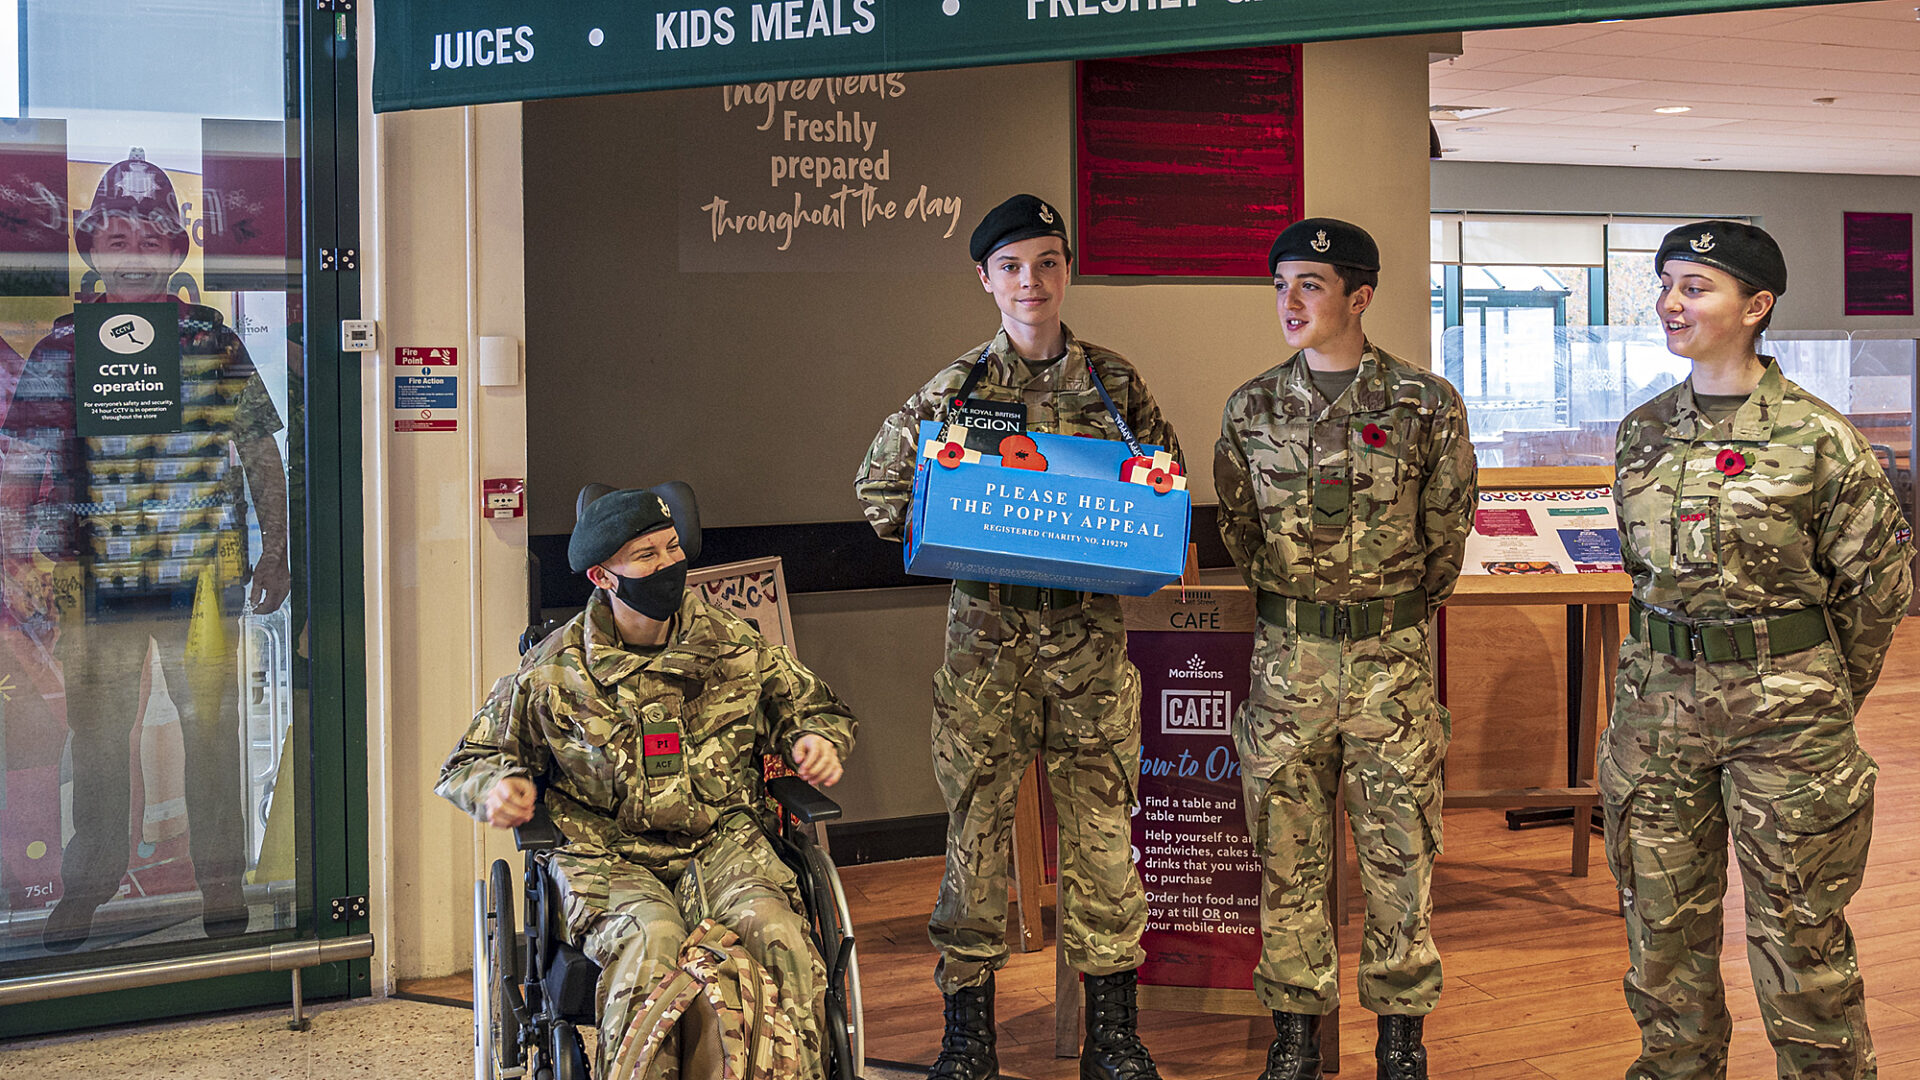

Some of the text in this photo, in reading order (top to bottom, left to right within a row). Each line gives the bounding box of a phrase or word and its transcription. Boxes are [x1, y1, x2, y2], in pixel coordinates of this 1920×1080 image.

[430, 0, 876, 71] JUICES KIDS MEALS
[783, 110, 878, 152] Freshly
[771, 149, 890, 188] prepared
[701, 182, 962, 251] throughout the day
[115, 324, 132, 335] CCTV
[402, 348, 418, 356] Fire
[402, 357, 423, 365] Point
[99, 363, 157, 376] CCTV in
[93, 380, 164, 396] operation
[141, 406, 168, 414] operation
[970, 408, 993, 417] ROYAL
[994, 411, 1021, 420] BRITISH
[955, 416, 1020, 433] LEGION
[1114, 413, 1133, 441] APPEAL
[986, 482, 1134, 514] PLEASE HELP
[950, 497, 1164, 538] THE POPPY APPEAL
[1680, 512, 1706, 522] CADET
[983, 523, 1128, 549] REGISTERED CHARITY NO. 219279
[1170, 607, 1221, 629] CAFÉ
[1169, 668, 1224, 679] Morrisons
[656, 760, 672, 769] ACF
[1140, 745, 1177, 776] ow
[1178, 748, 1199, 778] to
[1145, 796, 1237, 810] Find a table and
[1145, 810, 1223, 824] table number
[1145, 830, 1173, 843] Help
[1175, 831, 1223, 844] yourself
[1226, 833, 1239, 843] to
[1145, 844, 1214, 858] sandwiches,
[1217, 846, 1248, 858] cakes
[1145, 858, 1262, 873] drinks that you wish
[1145, 873, 1213, 886] to purchase
[25, 882, 53, 898] 75cl
[1145, 891, 1259, 906] Order hot food and
[1167, 907, 1180, 917] at
[1182, 907, 1199, 918] till
[1202, 908, 1221, 921] OR
[1224, 910, 1239, 920] on
[1145, 921, 1256, 935] your mobile device
